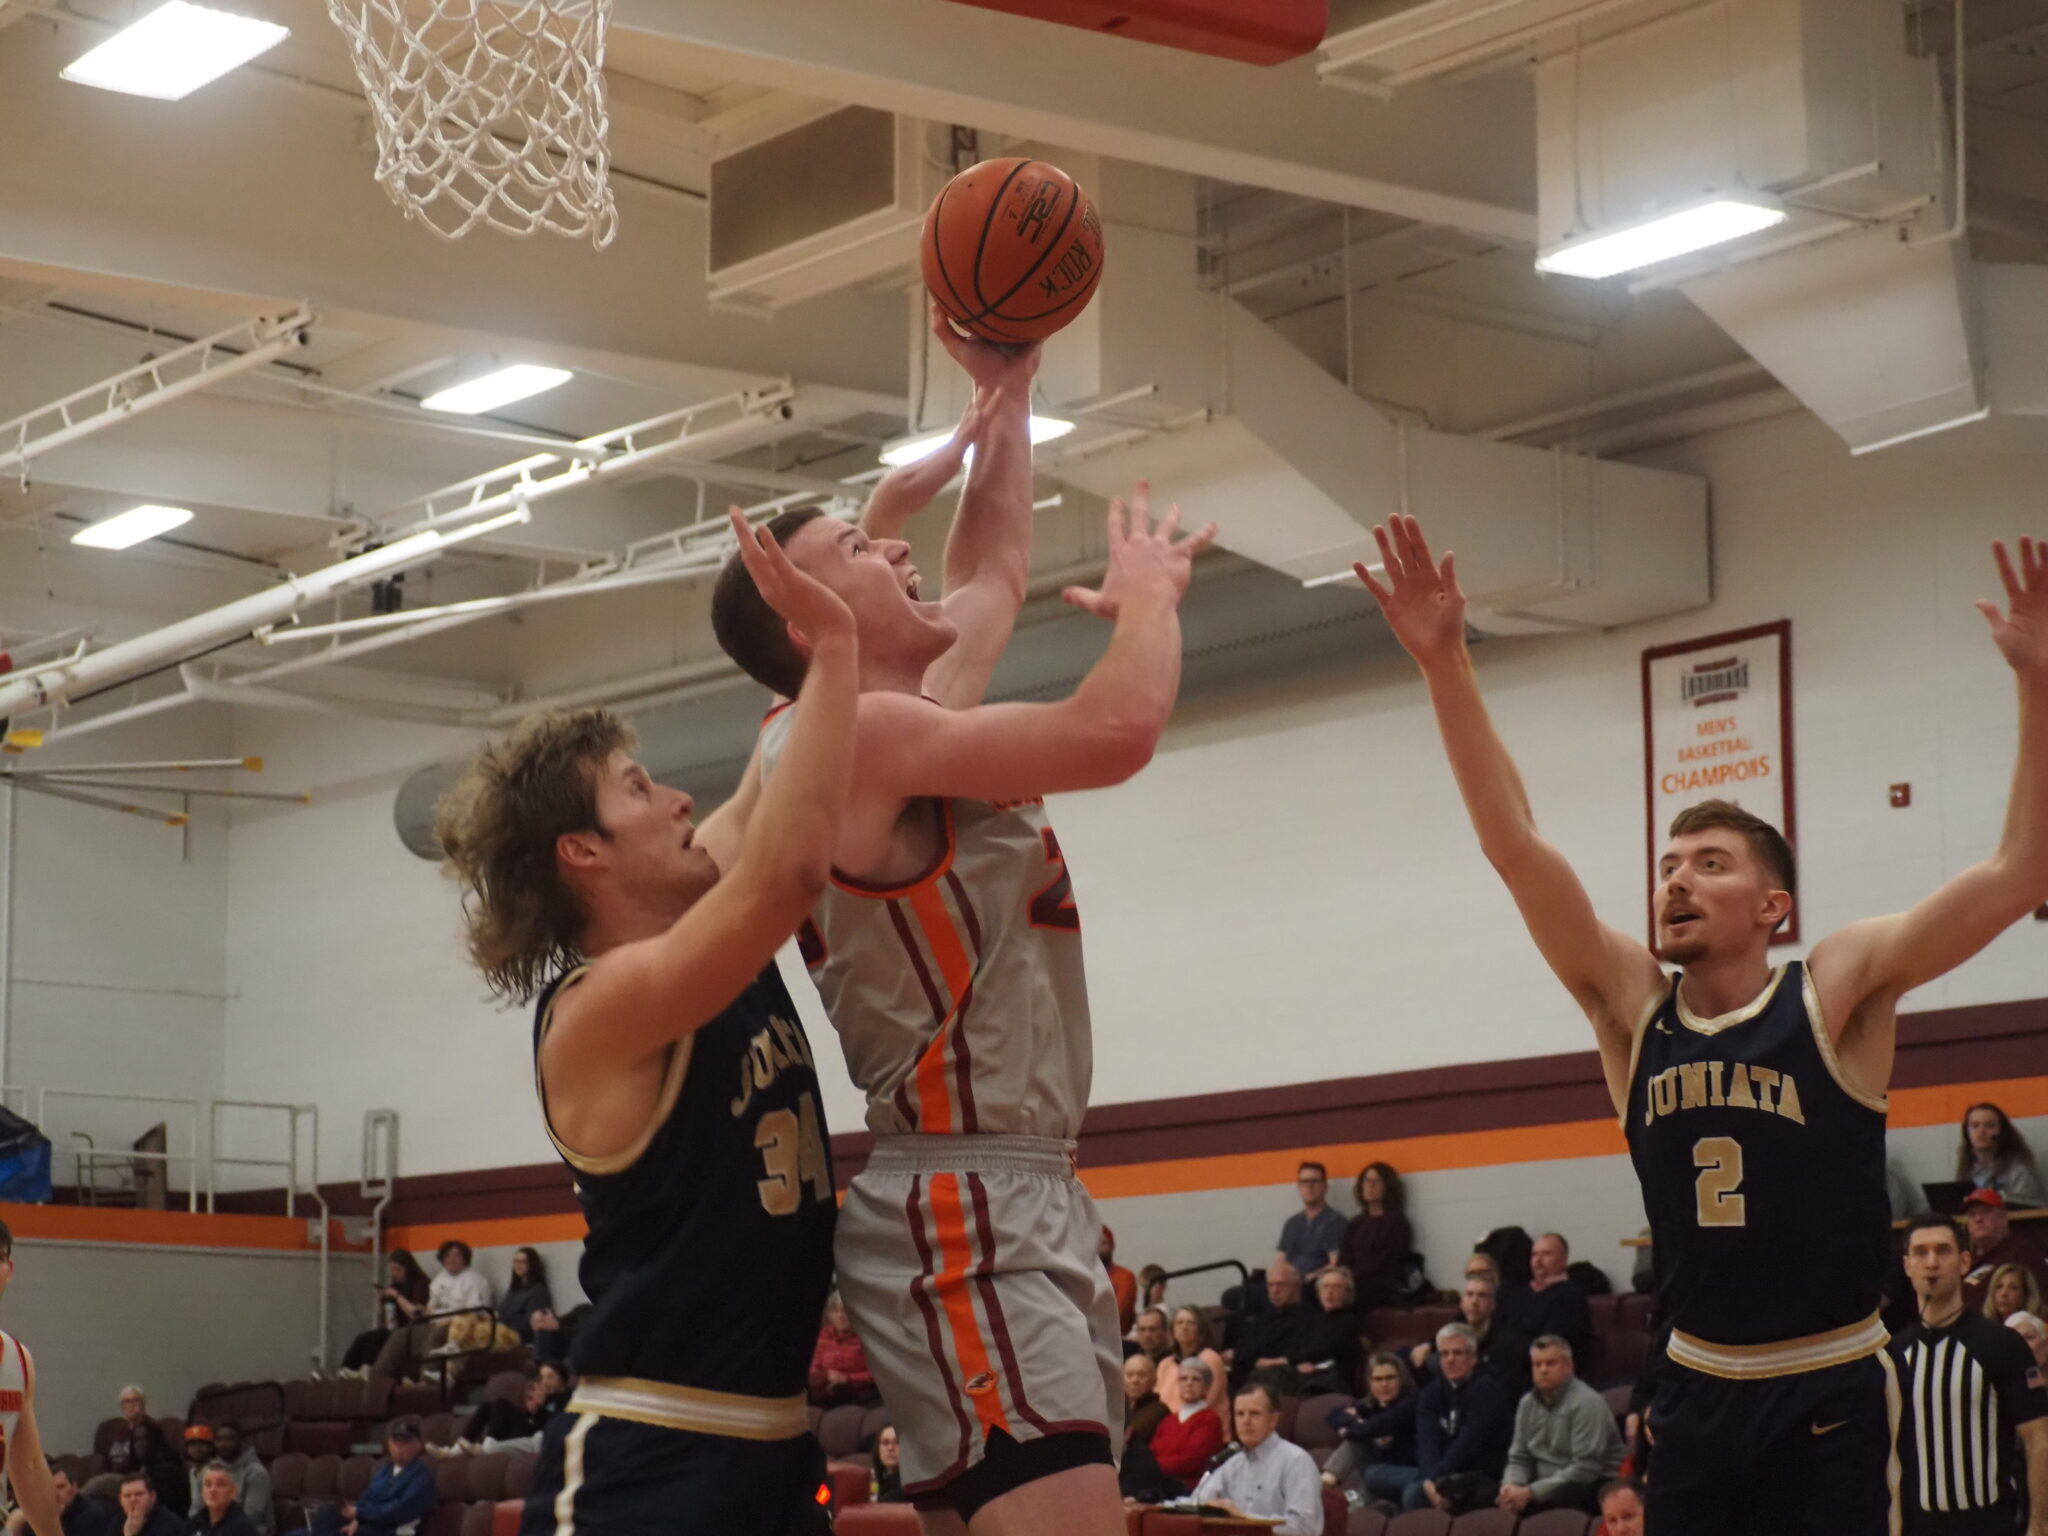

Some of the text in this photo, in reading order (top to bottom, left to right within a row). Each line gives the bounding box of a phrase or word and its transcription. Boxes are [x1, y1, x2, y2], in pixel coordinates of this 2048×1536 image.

[1039, 238, 1093, 298] ROCK
[1678, 738, 1752, 762] BASKETBALL
[1696, 717, 1736, 735] MEN'S
[1661, 757, 1770, 794] CHAMPIONS
[1645, 1061, 1805, 1126] JUNIATA
[753, 1091, 831, 1216] 34
[1692, 1136, 1746, 1226] 2
